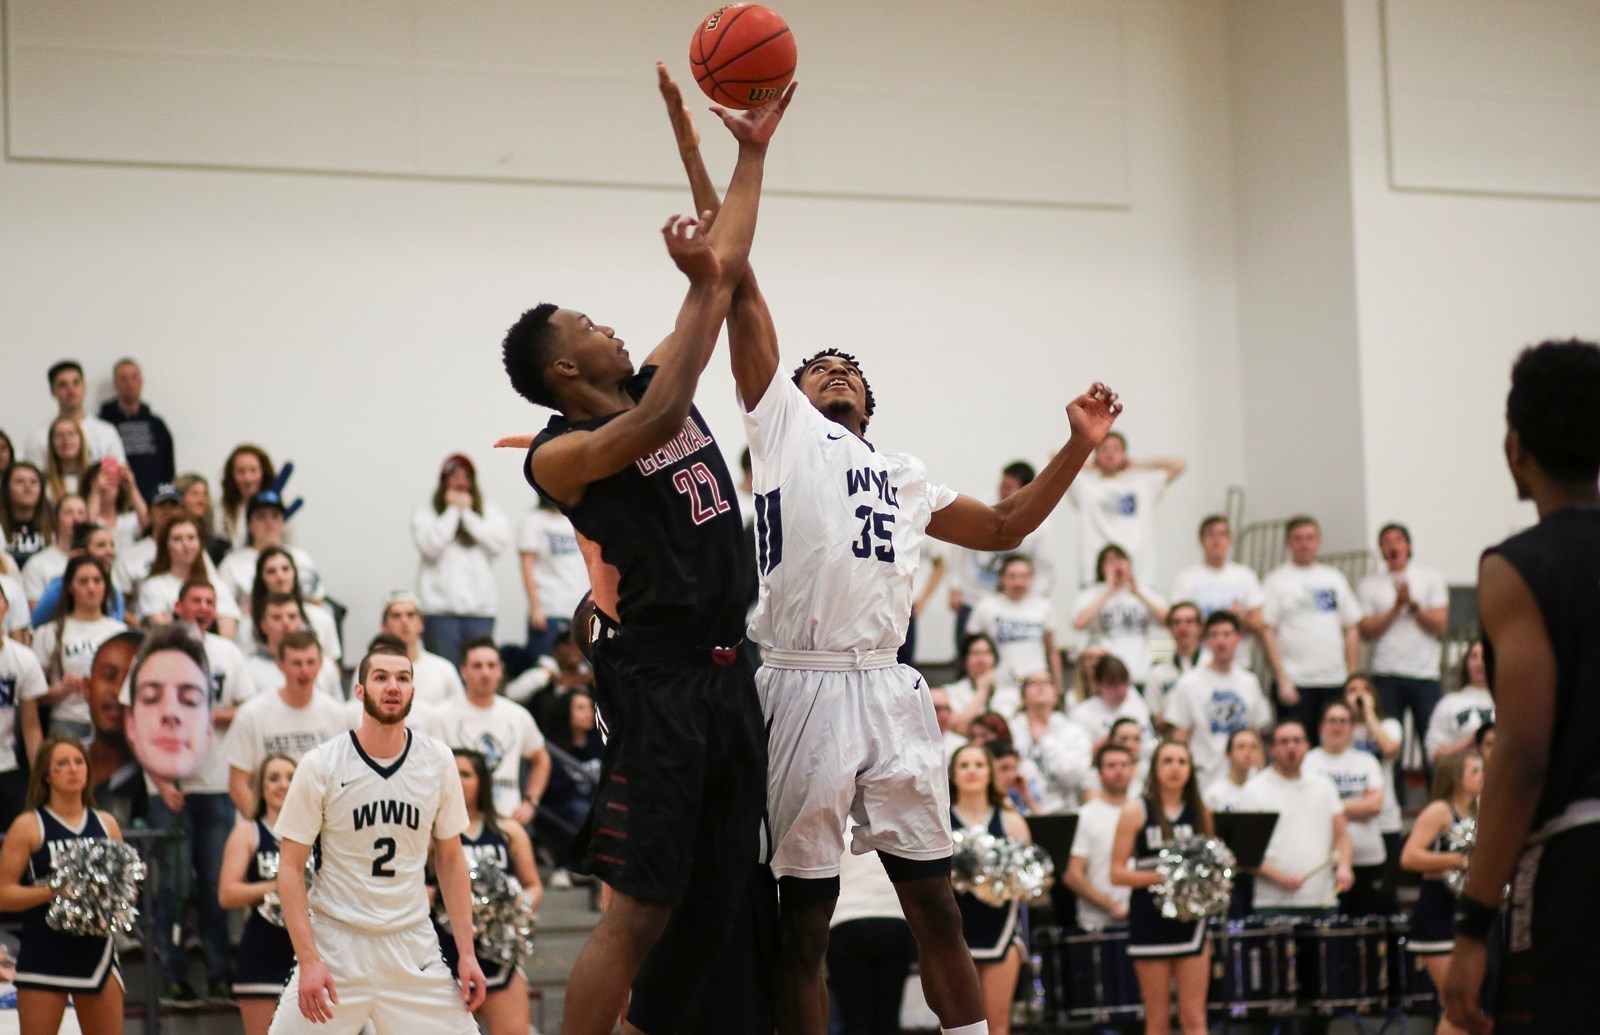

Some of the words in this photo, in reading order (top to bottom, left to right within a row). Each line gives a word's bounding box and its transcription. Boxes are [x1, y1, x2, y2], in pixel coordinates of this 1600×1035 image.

[673, 462, 731, 525] 22
[852, 504, 896, 564] 35
[353, 799, 420, 831] WWU
[372, 837, 397, 878] 2
